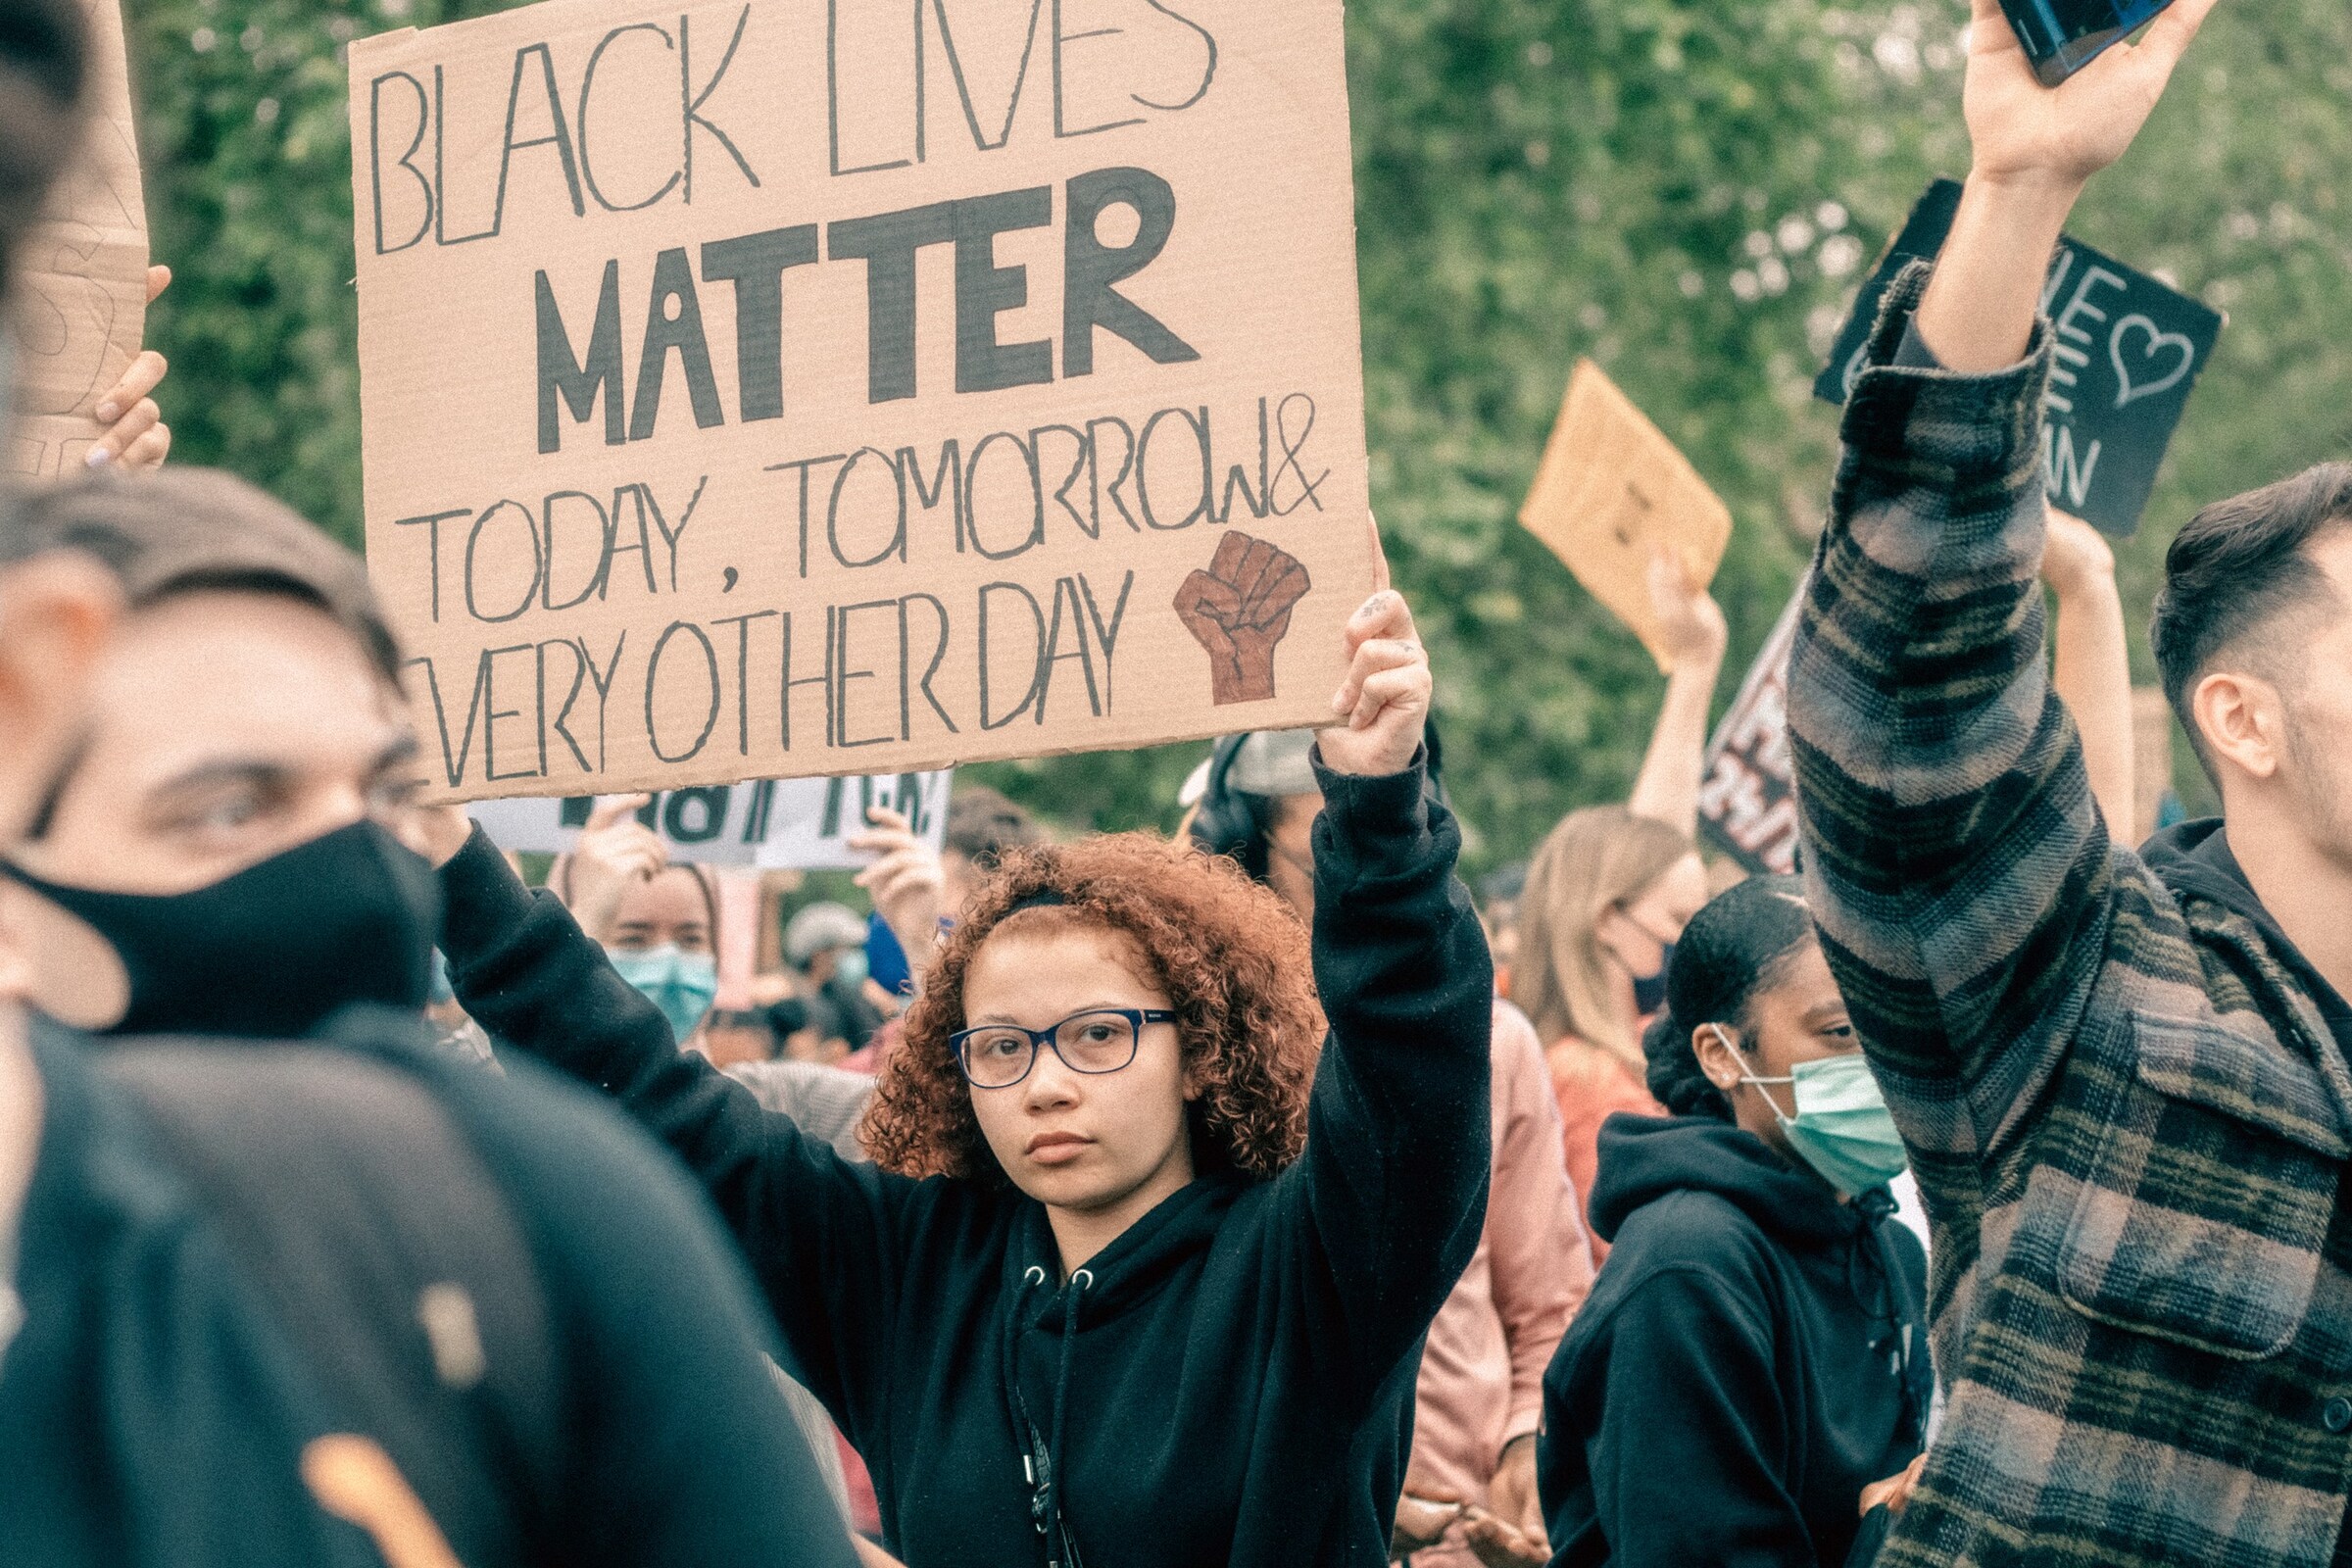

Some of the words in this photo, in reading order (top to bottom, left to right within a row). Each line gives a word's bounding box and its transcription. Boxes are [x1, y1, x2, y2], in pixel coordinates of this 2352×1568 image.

[370, 4, 760, 254] BLACK
[828, 0, 1217, 176] LIVES
[534, 167, 1200, 454] MATTER
[402, 629, 625, 788] VERY
[645, 594, 958, 763] OTHER
[979, 570, 1134, 731] DAY
